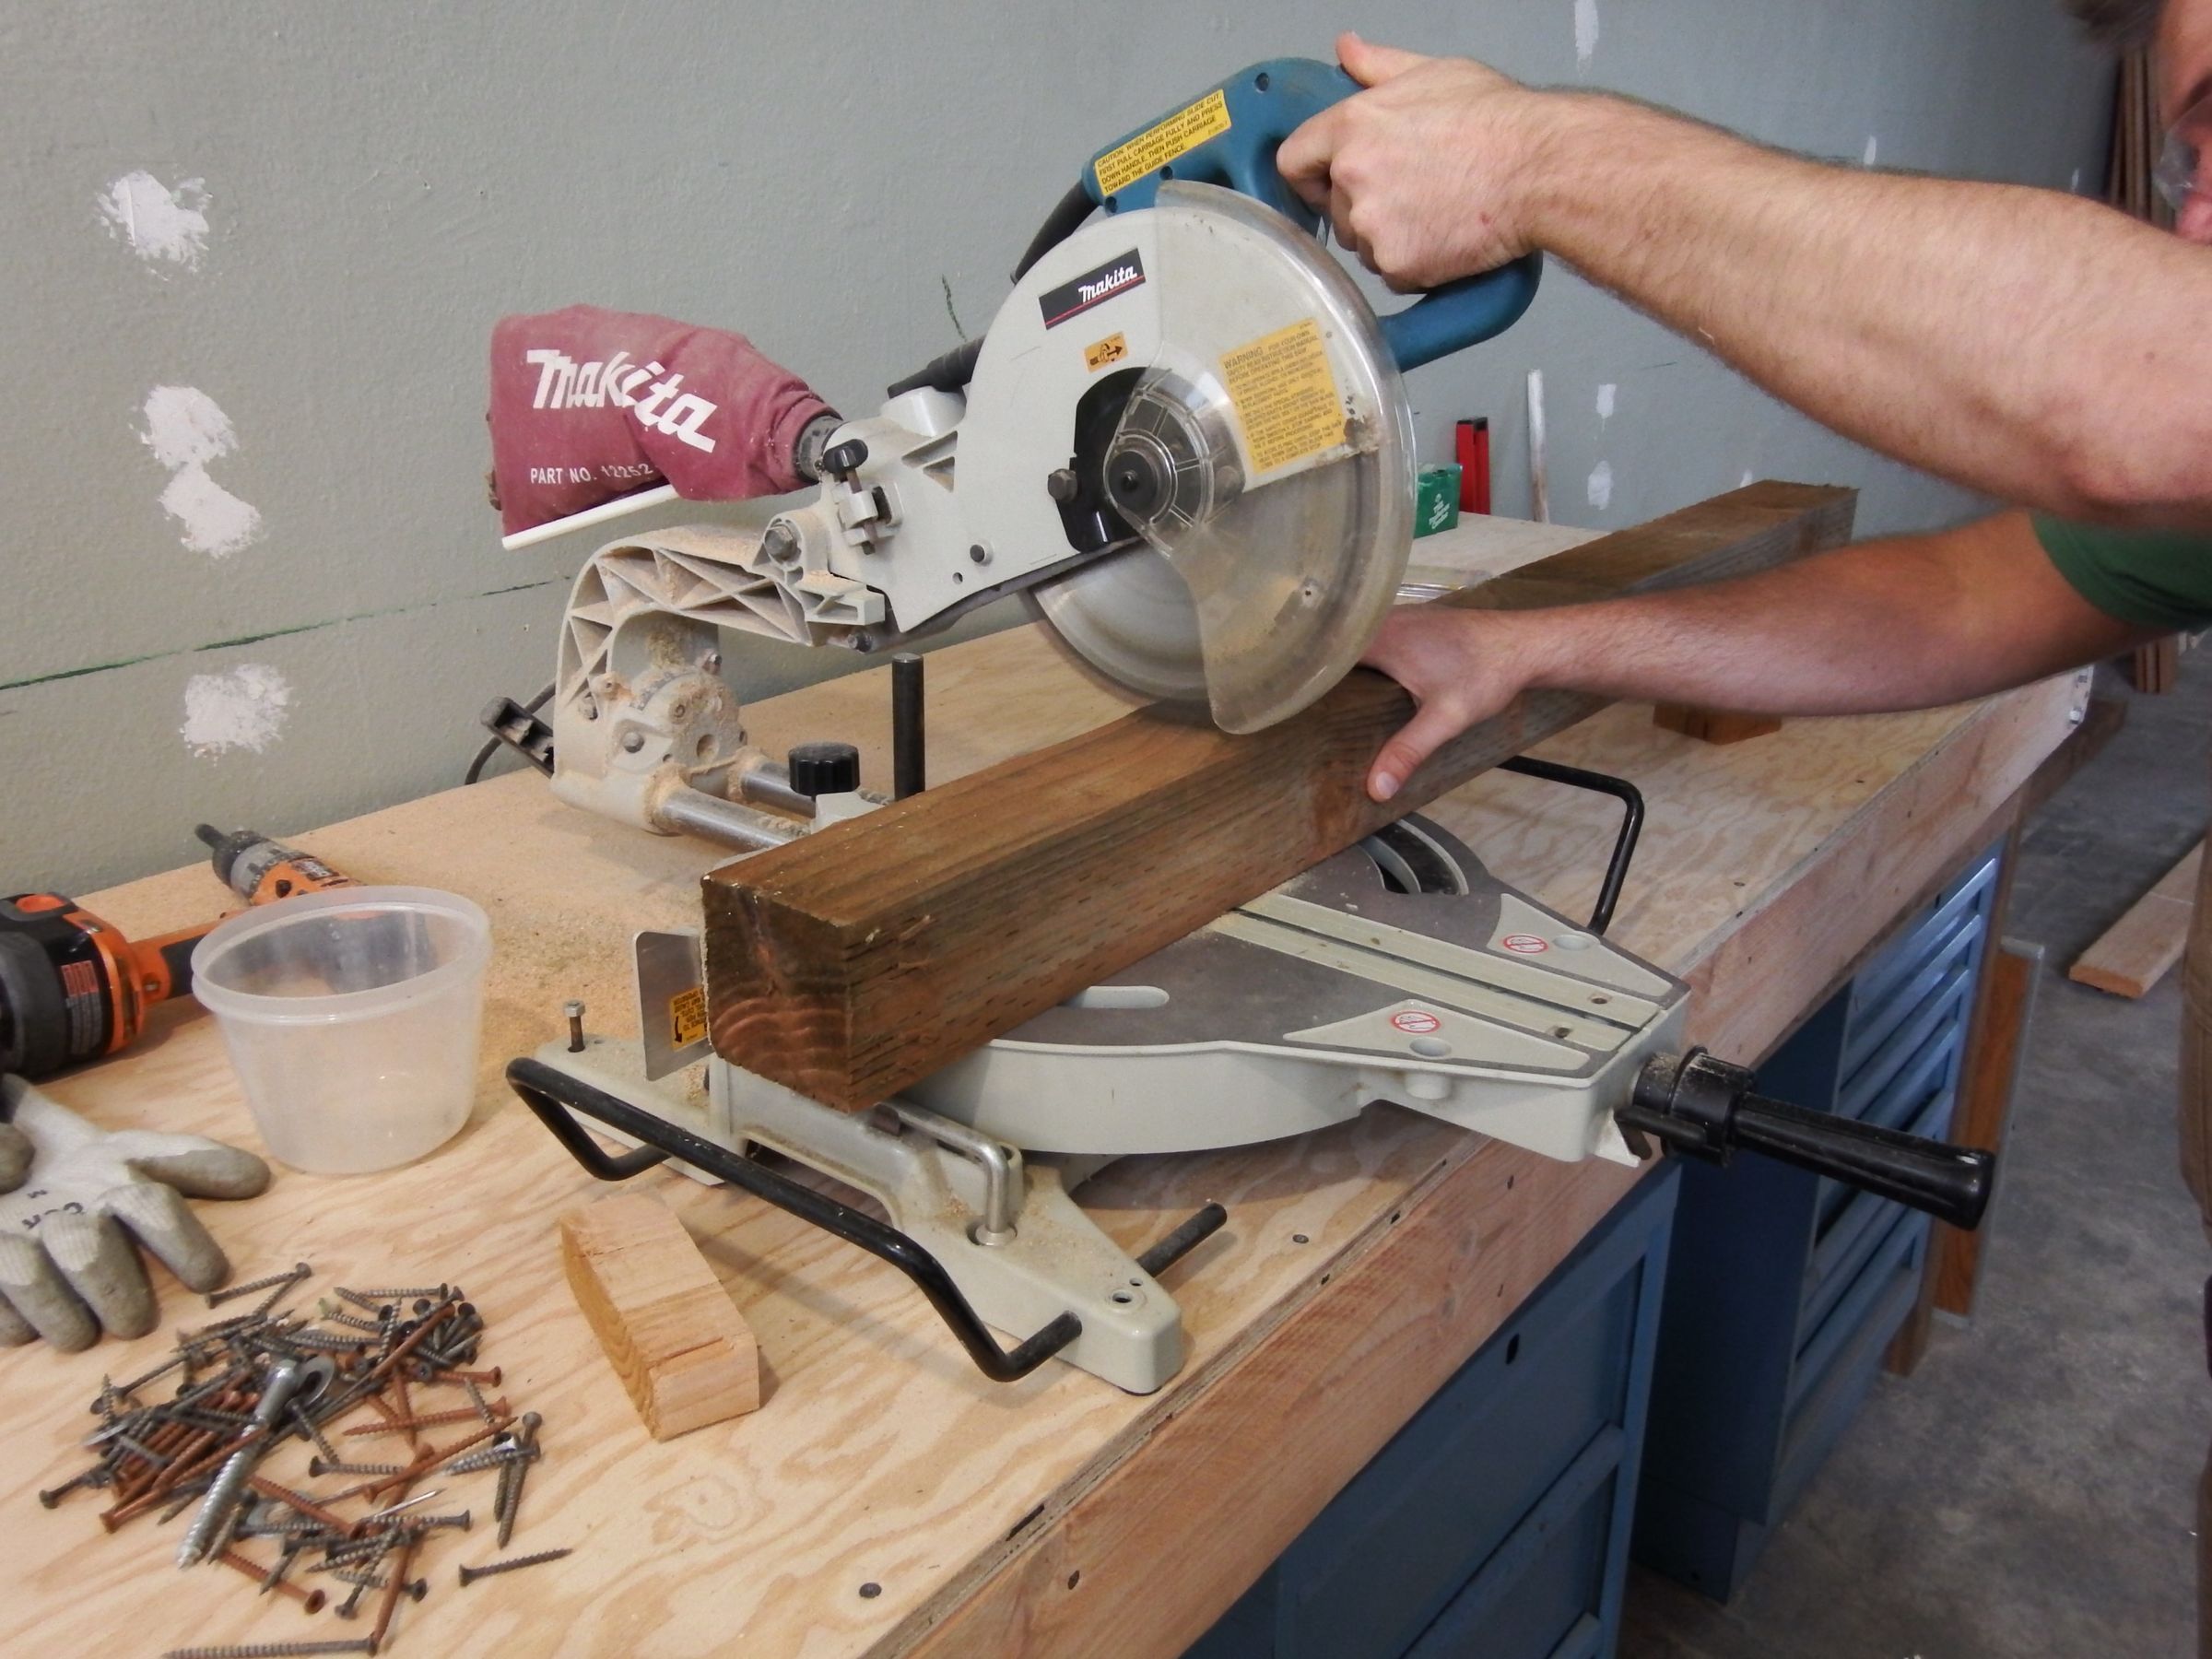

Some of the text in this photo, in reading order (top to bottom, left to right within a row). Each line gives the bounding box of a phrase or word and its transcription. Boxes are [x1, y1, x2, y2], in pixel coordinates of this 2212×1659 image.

[1102, 171, 1121, 184] DOWN
[1148, 145, 1165, 158] THEN
[1166, 135, 1182, 148] PUSH
[1183, 116, 1216, 137] CARRIAGE
[1117, 154, 1132, 166] PULL
[1134, 135, 1163, 156] CARRIAGE
[1165, 123, 1185, 137] FULLY
[1186, 114, 1200, 125] AND
[1201, 101, 1222, 117] PRESS
[1105, 174, 1130, 193] TOWARD
[1132, 168, 1143, 177] THE
[1145, 157, 1163, 171] GUIDE
[530, 467, 563, 484] PART
[569, 466, 597, 483] NO.
